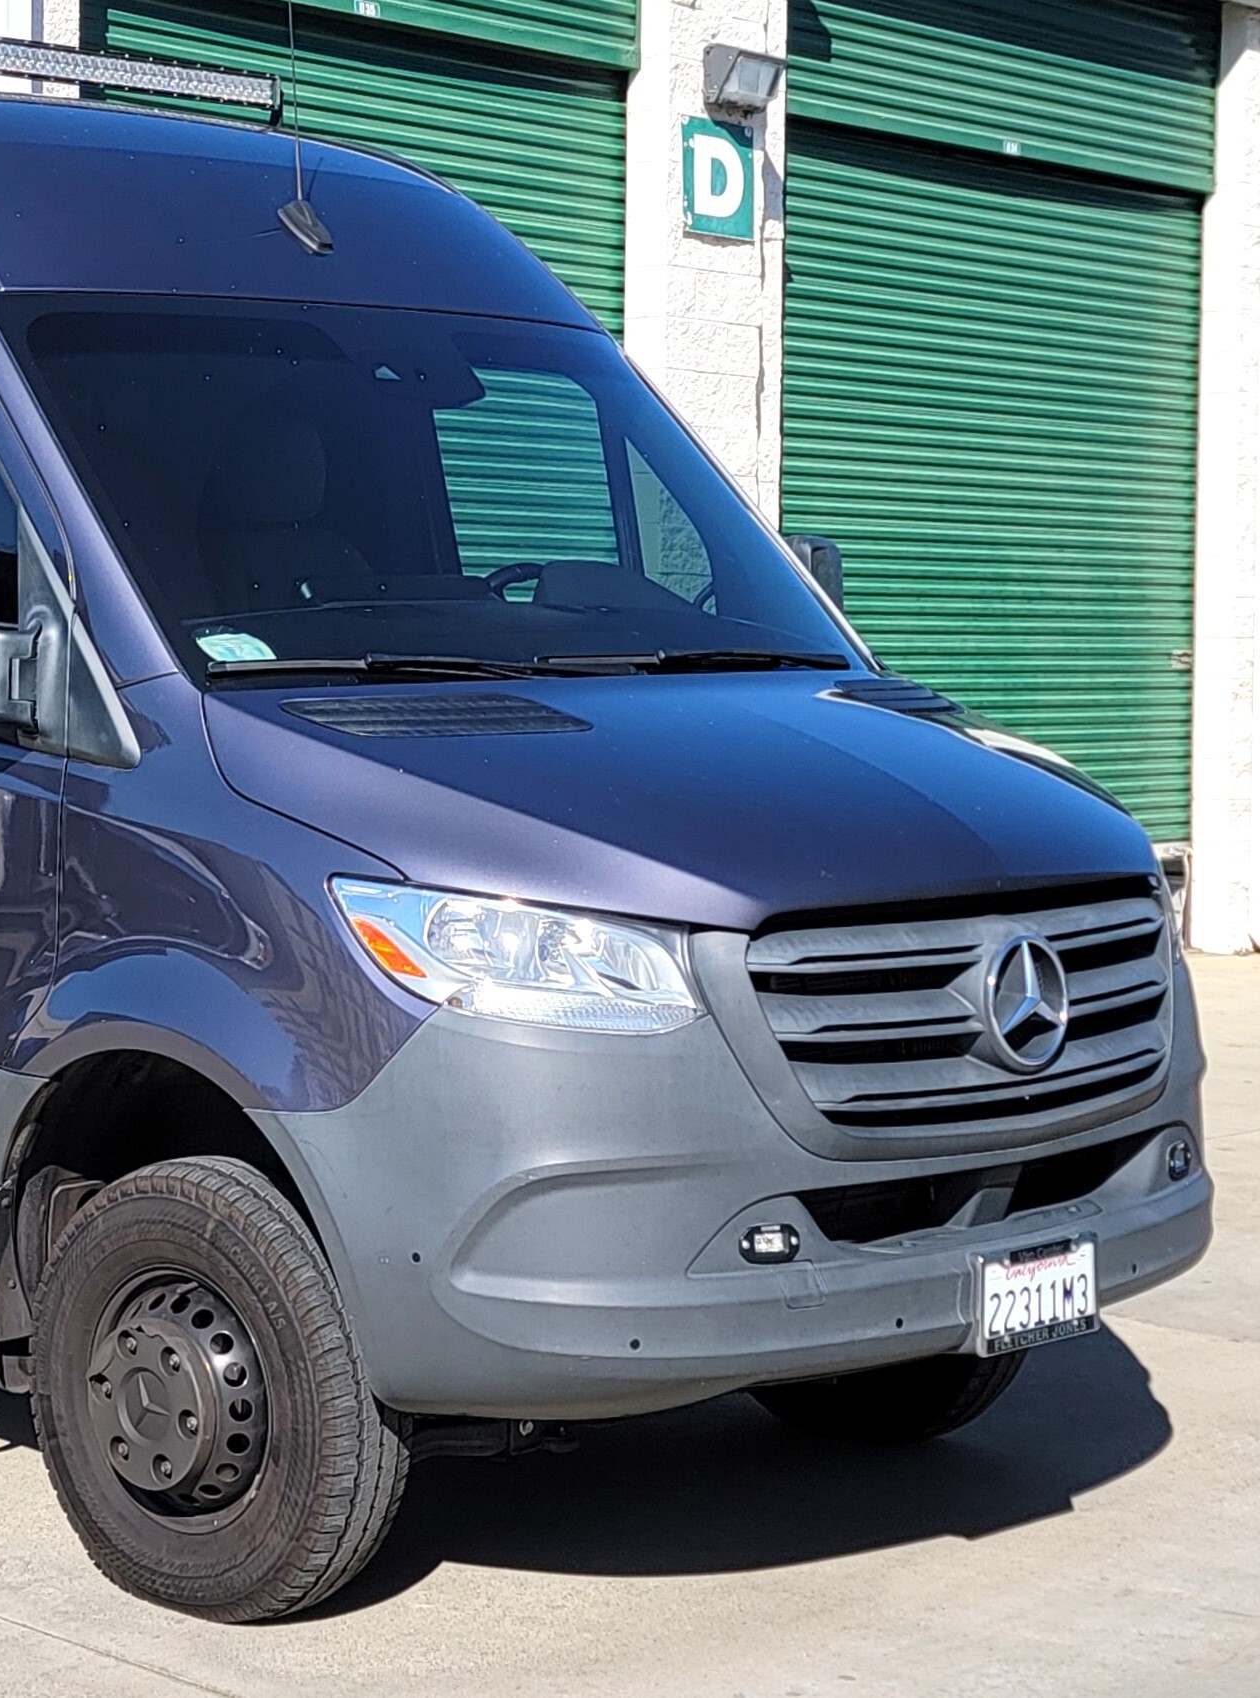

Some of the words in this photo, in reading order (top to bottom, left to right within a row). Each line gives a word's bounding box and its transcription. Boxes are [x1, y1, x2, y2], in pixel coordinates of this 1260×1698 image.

[693, 133, 745, 218] D
[988, 1273, 1088, 1338] 22311M3
[994, 1329, 1050, 1352] FLETCHER
[1052, 1318, 1087, 1338] JONES
